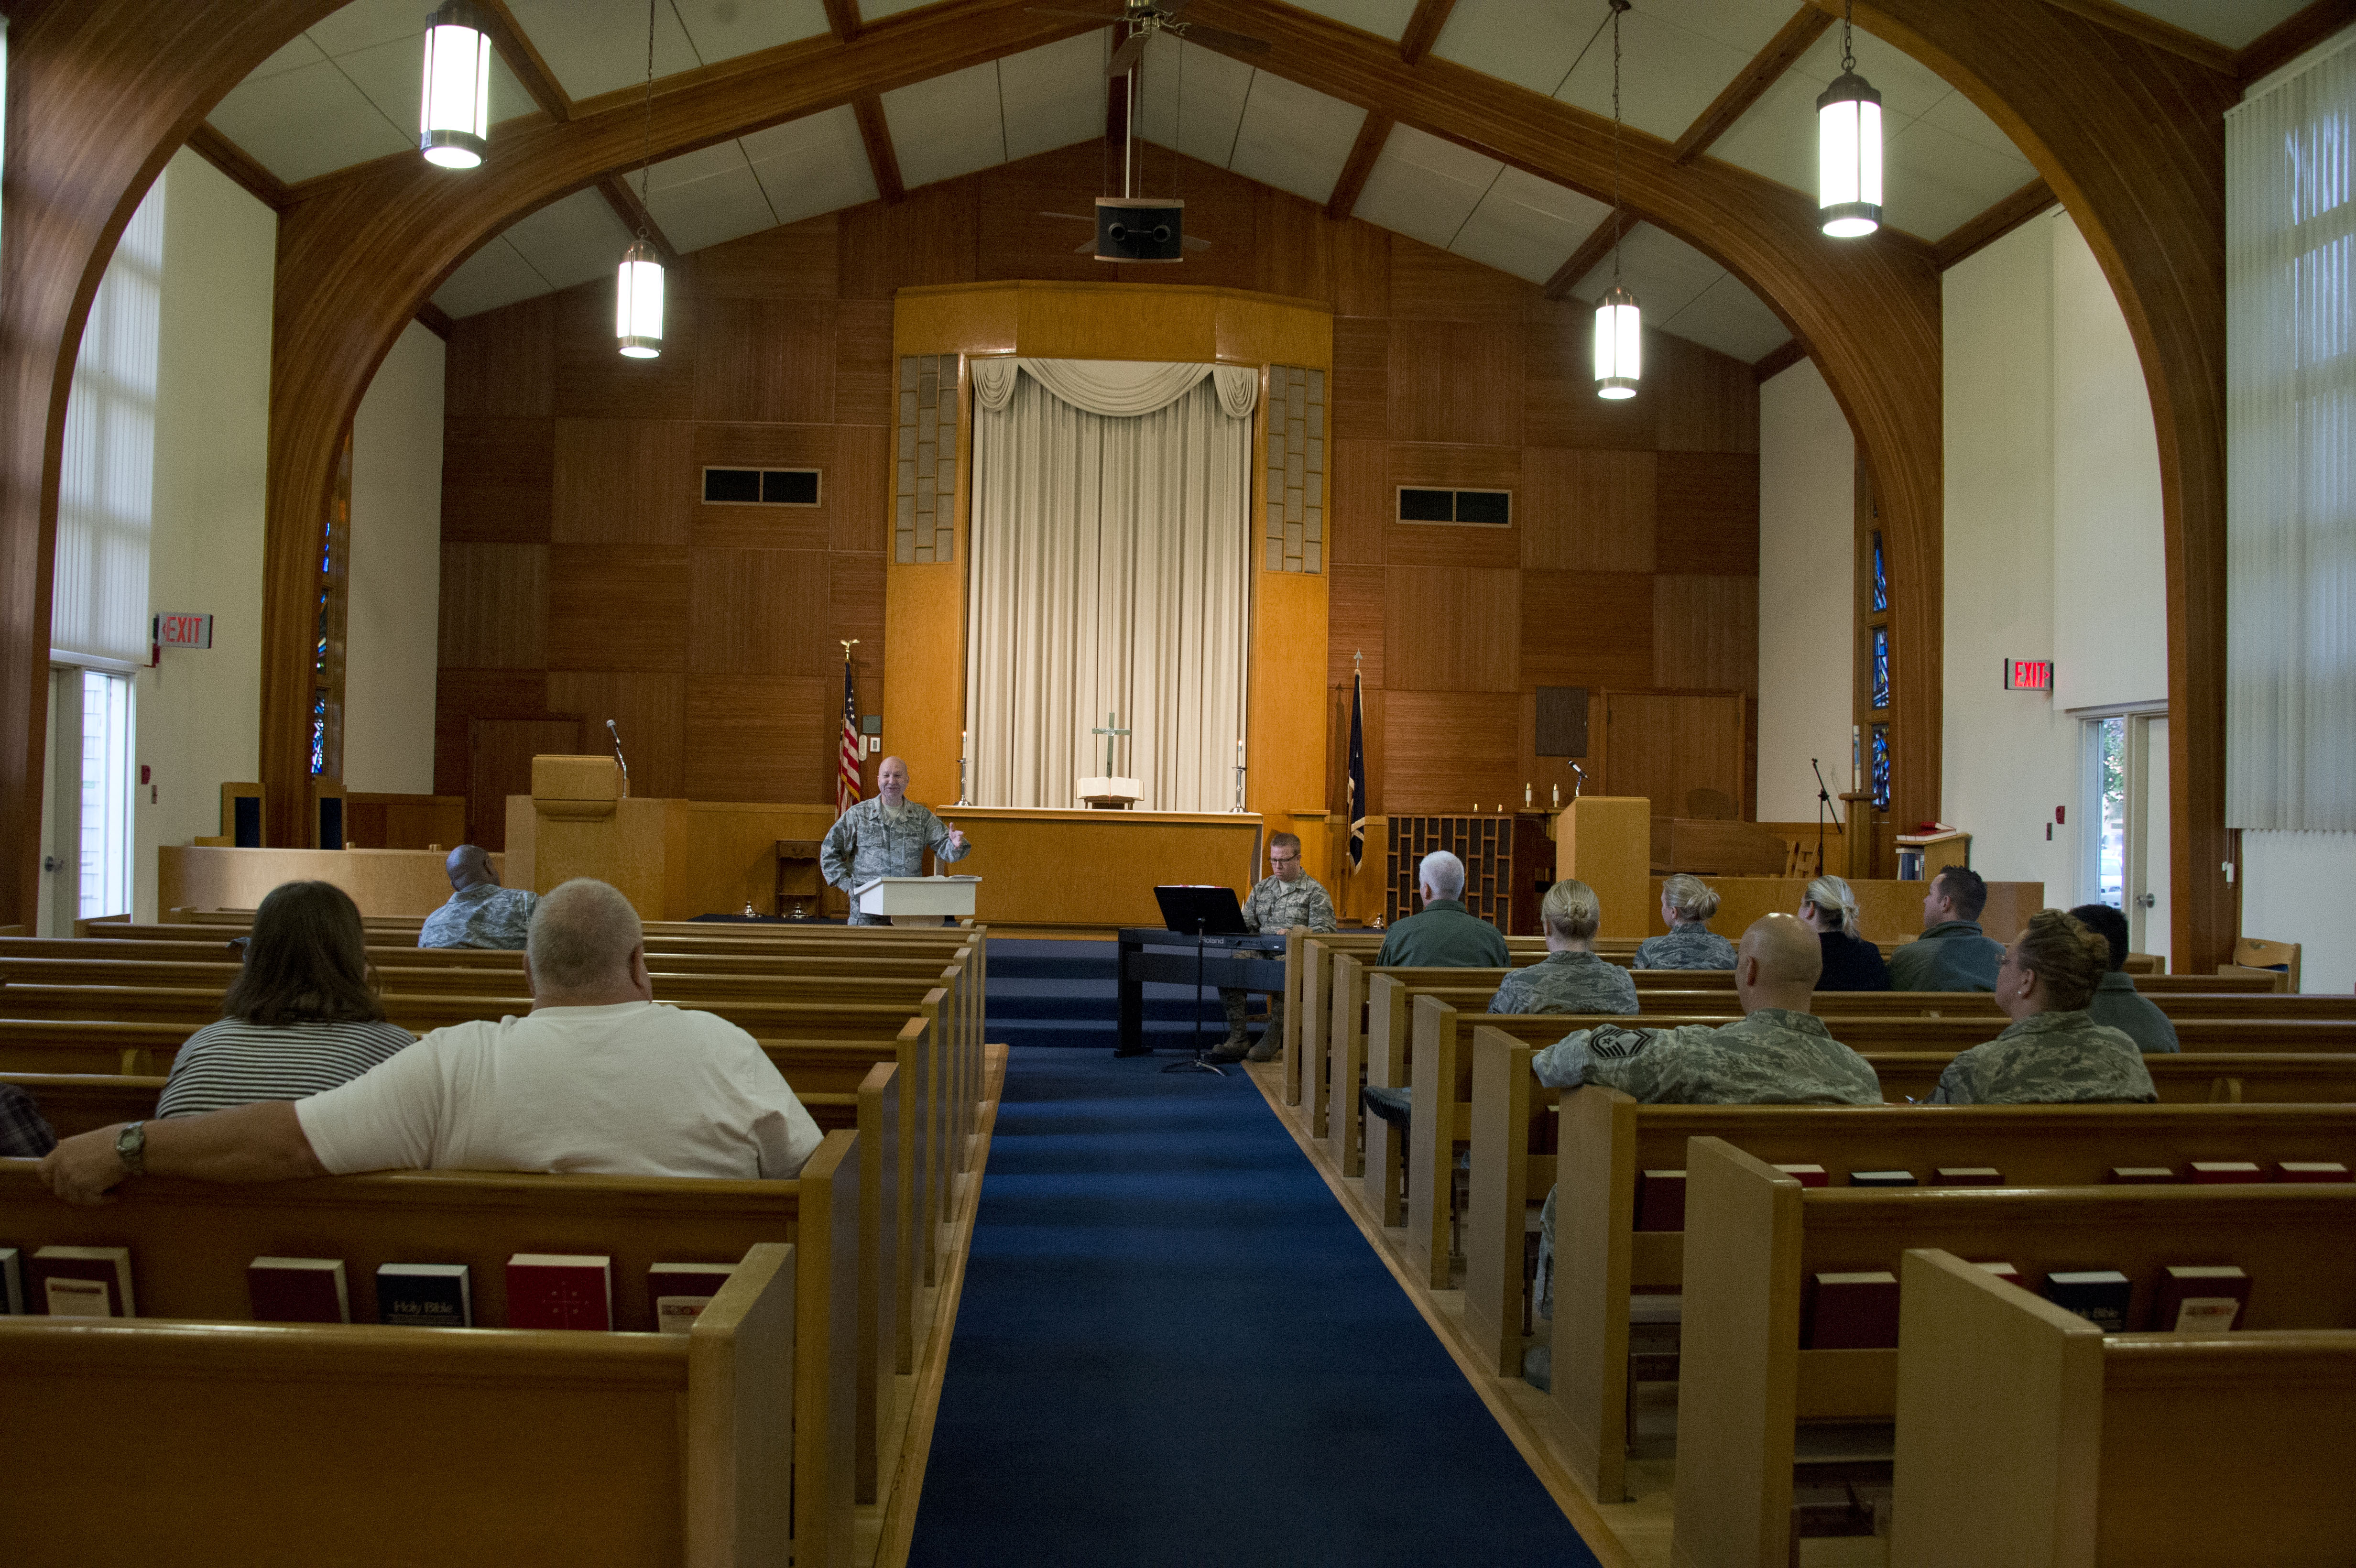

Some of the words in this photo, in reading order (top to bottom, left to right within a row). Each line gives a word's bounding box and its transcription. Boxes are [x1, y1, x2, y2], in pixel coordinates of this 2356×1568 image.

[166, 616, 202, 643] EXIT
[2015, 662, 2047, 687] EXIT
[393, 1300, 422, 1314] Holy
[424, 1301, 453, 1314] Bible
